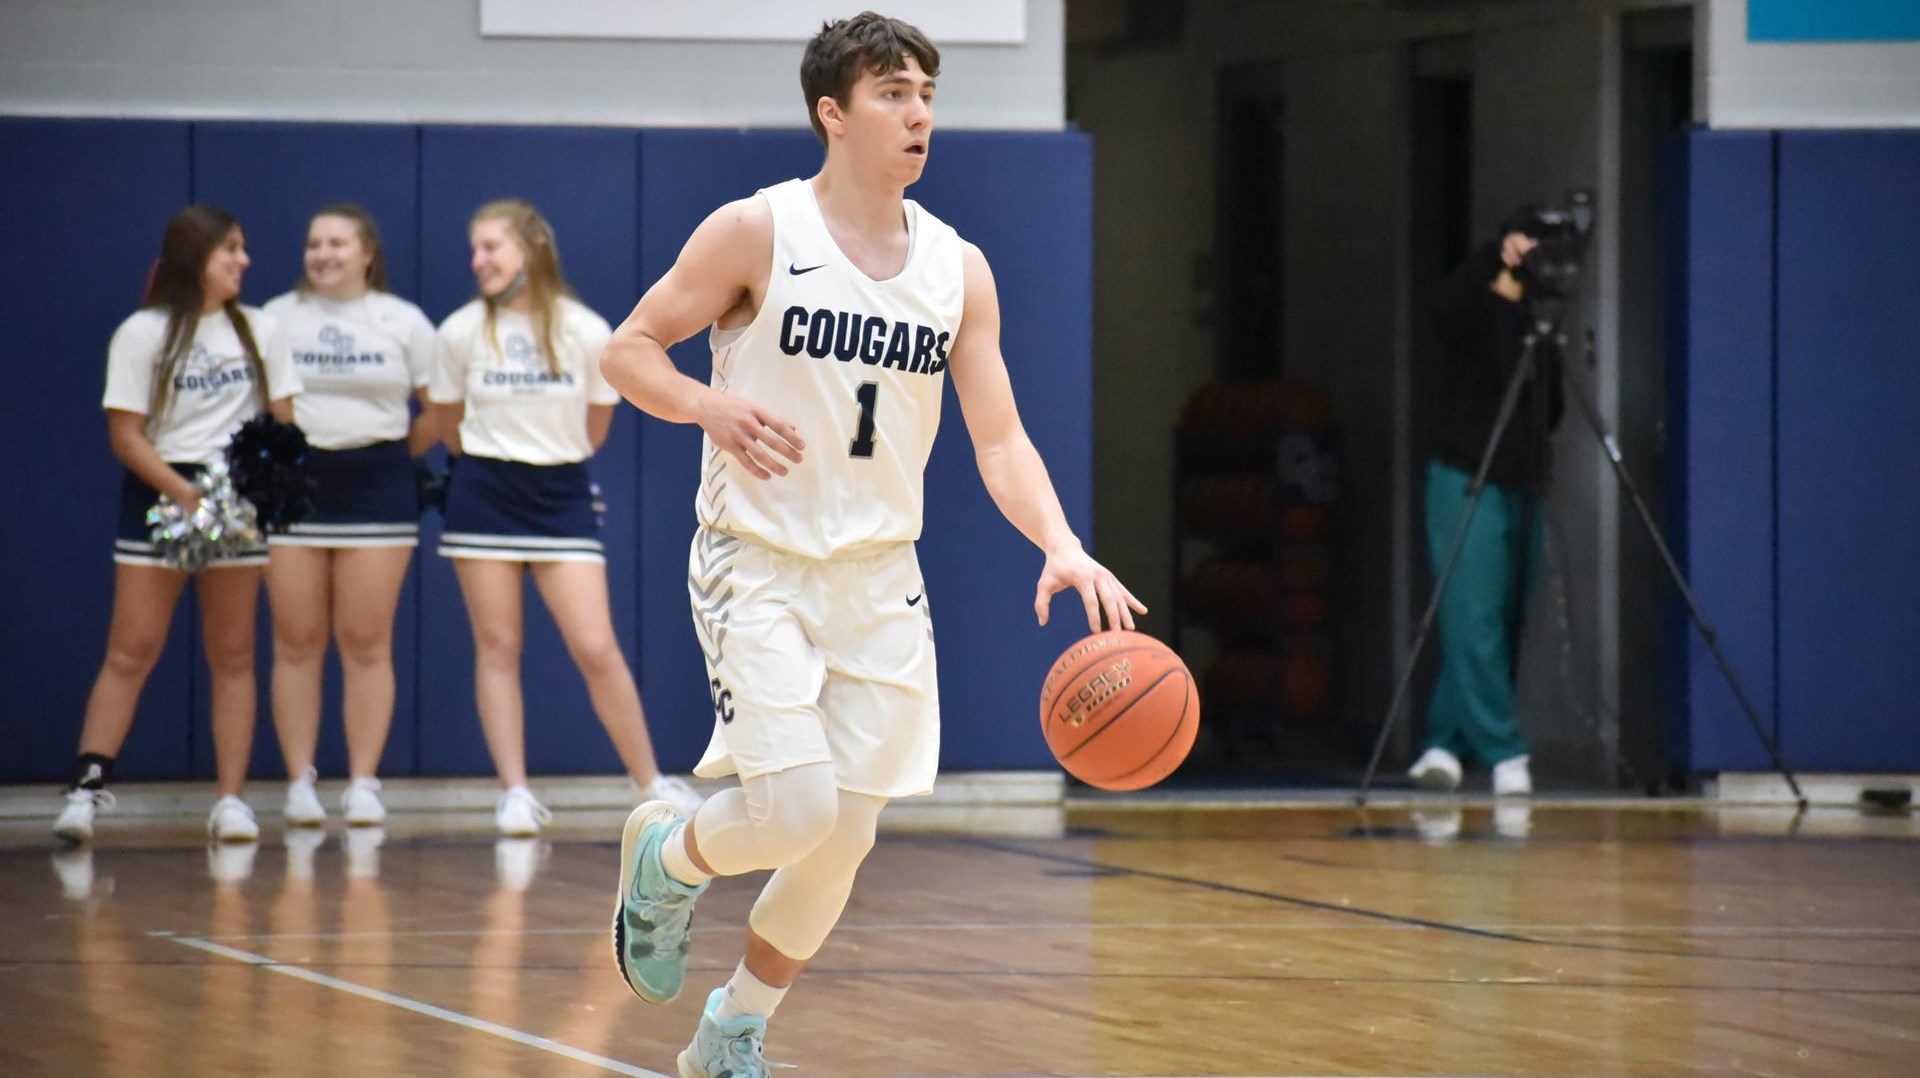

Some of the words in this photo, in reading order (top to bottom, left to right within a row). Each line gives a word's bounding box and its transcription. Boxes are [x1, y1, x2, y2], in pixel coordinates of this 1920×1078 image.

[292, 350, 385, 366] COUGARS
[779, 305, 950, 375] COUGARS
[849, 380, 880, 460] 1
[1058, 658, 1131, 724] LEGACY
